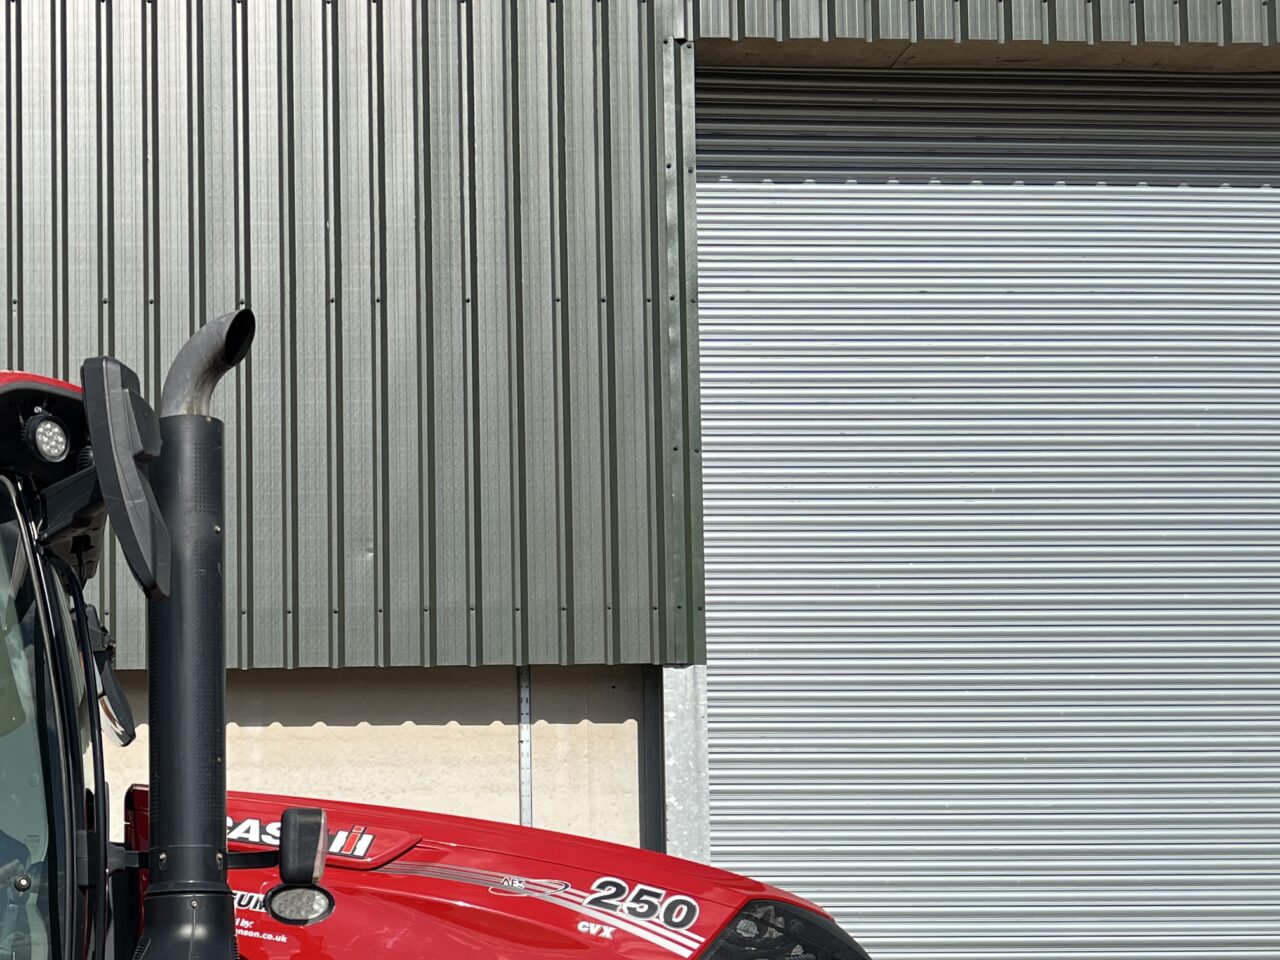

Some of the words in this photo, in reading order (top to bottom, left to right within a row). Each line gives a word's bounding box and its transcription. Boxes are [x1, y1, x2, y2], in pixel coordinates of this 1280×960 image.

[227, 816, 281, 846] AS
[582, 876, 700, 931] 250
[577, 920, 617, 939] CVX
